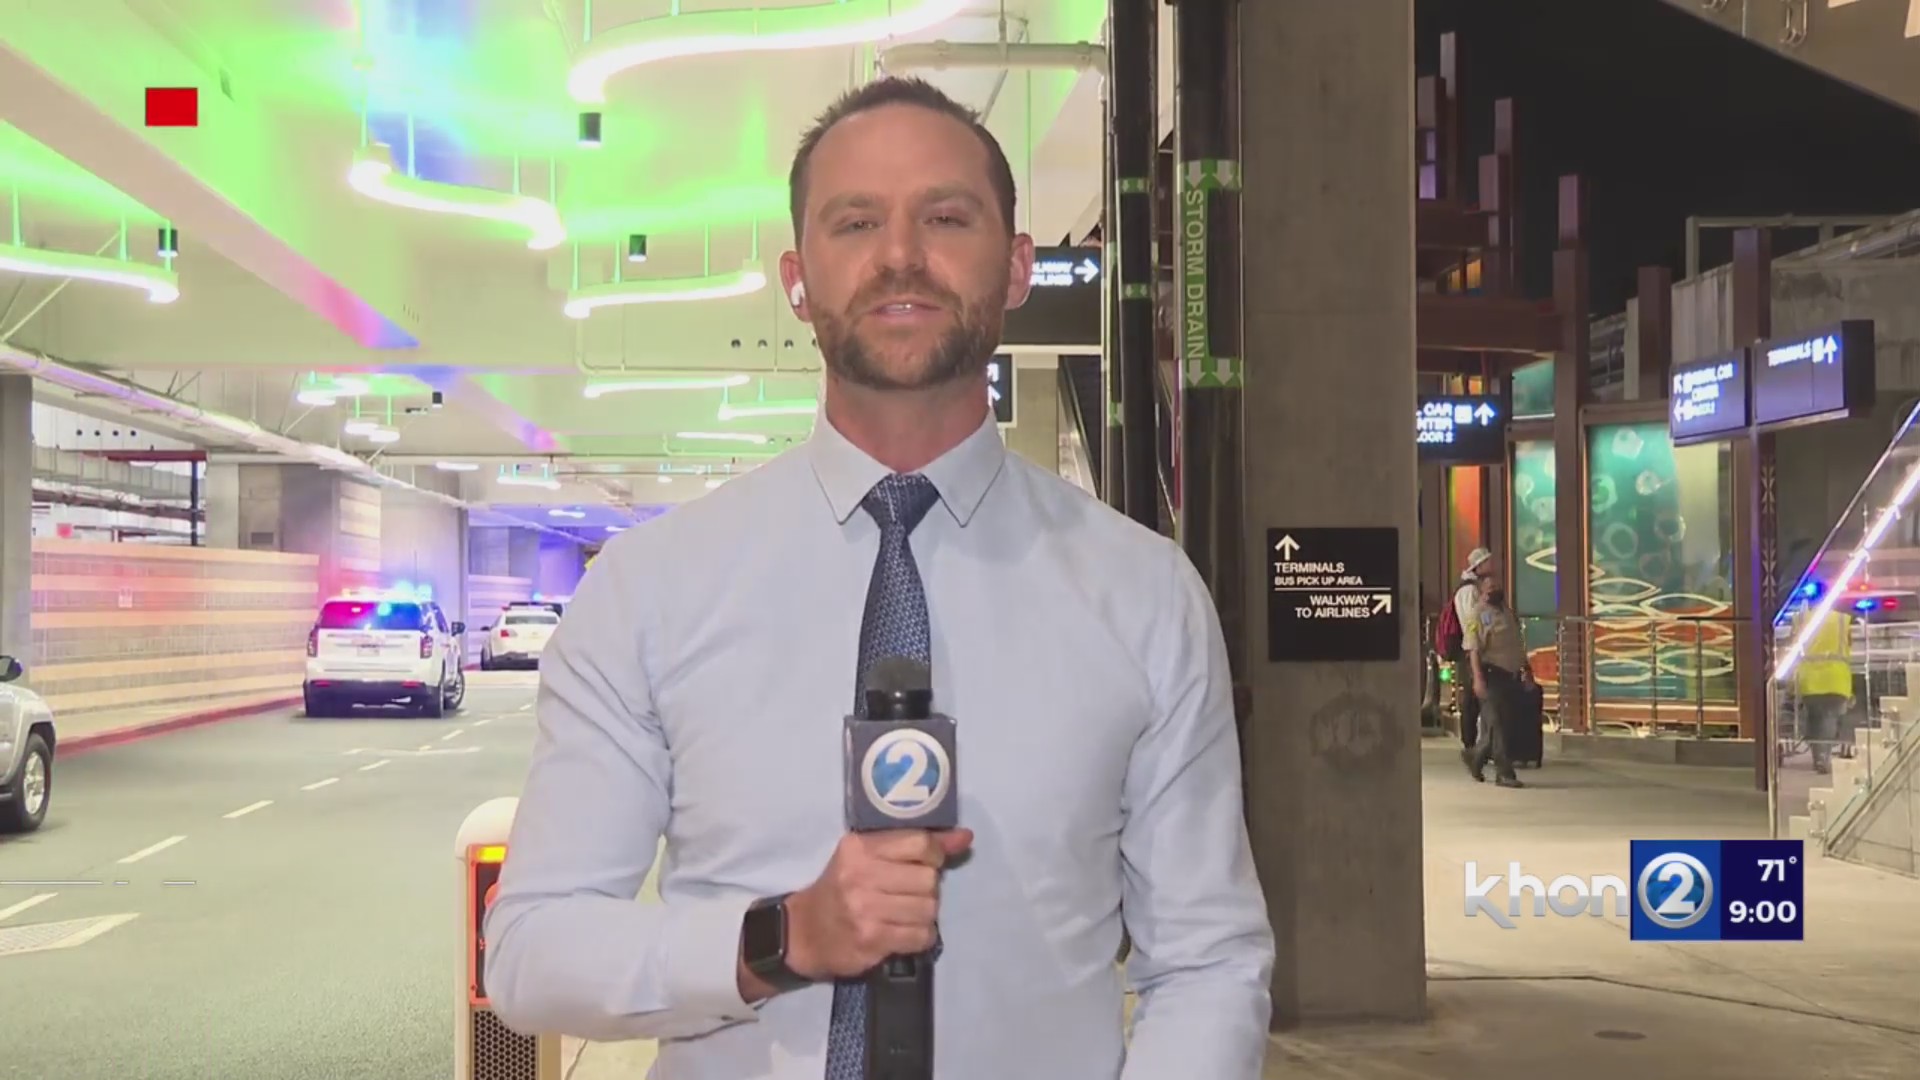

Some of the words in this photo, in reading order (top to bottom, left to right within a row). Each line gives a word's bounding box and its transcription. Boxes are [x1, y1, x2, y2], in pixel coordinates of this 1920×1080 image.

[1186, 189, 1204, 275] STORM
[1186, 283, 1204, 358] DRAIN
[1416, 417, 1453, 430] NTER
[1274, 562, 1345, 573] TERMINALS
[1274, 576, 1295, 586] BUS
[1297, 576, 1320, 586] PICK
[1321, 576, 1336, 586] UP
[1336, 576, 1363, 586] AREA
[1309, 595, 1370, 606] WALKWAY
[1294, 607, 1312, 618] TO
[1314, 607, 1371, 618] AIRLINES
[882, 740, 931, 801] 2
